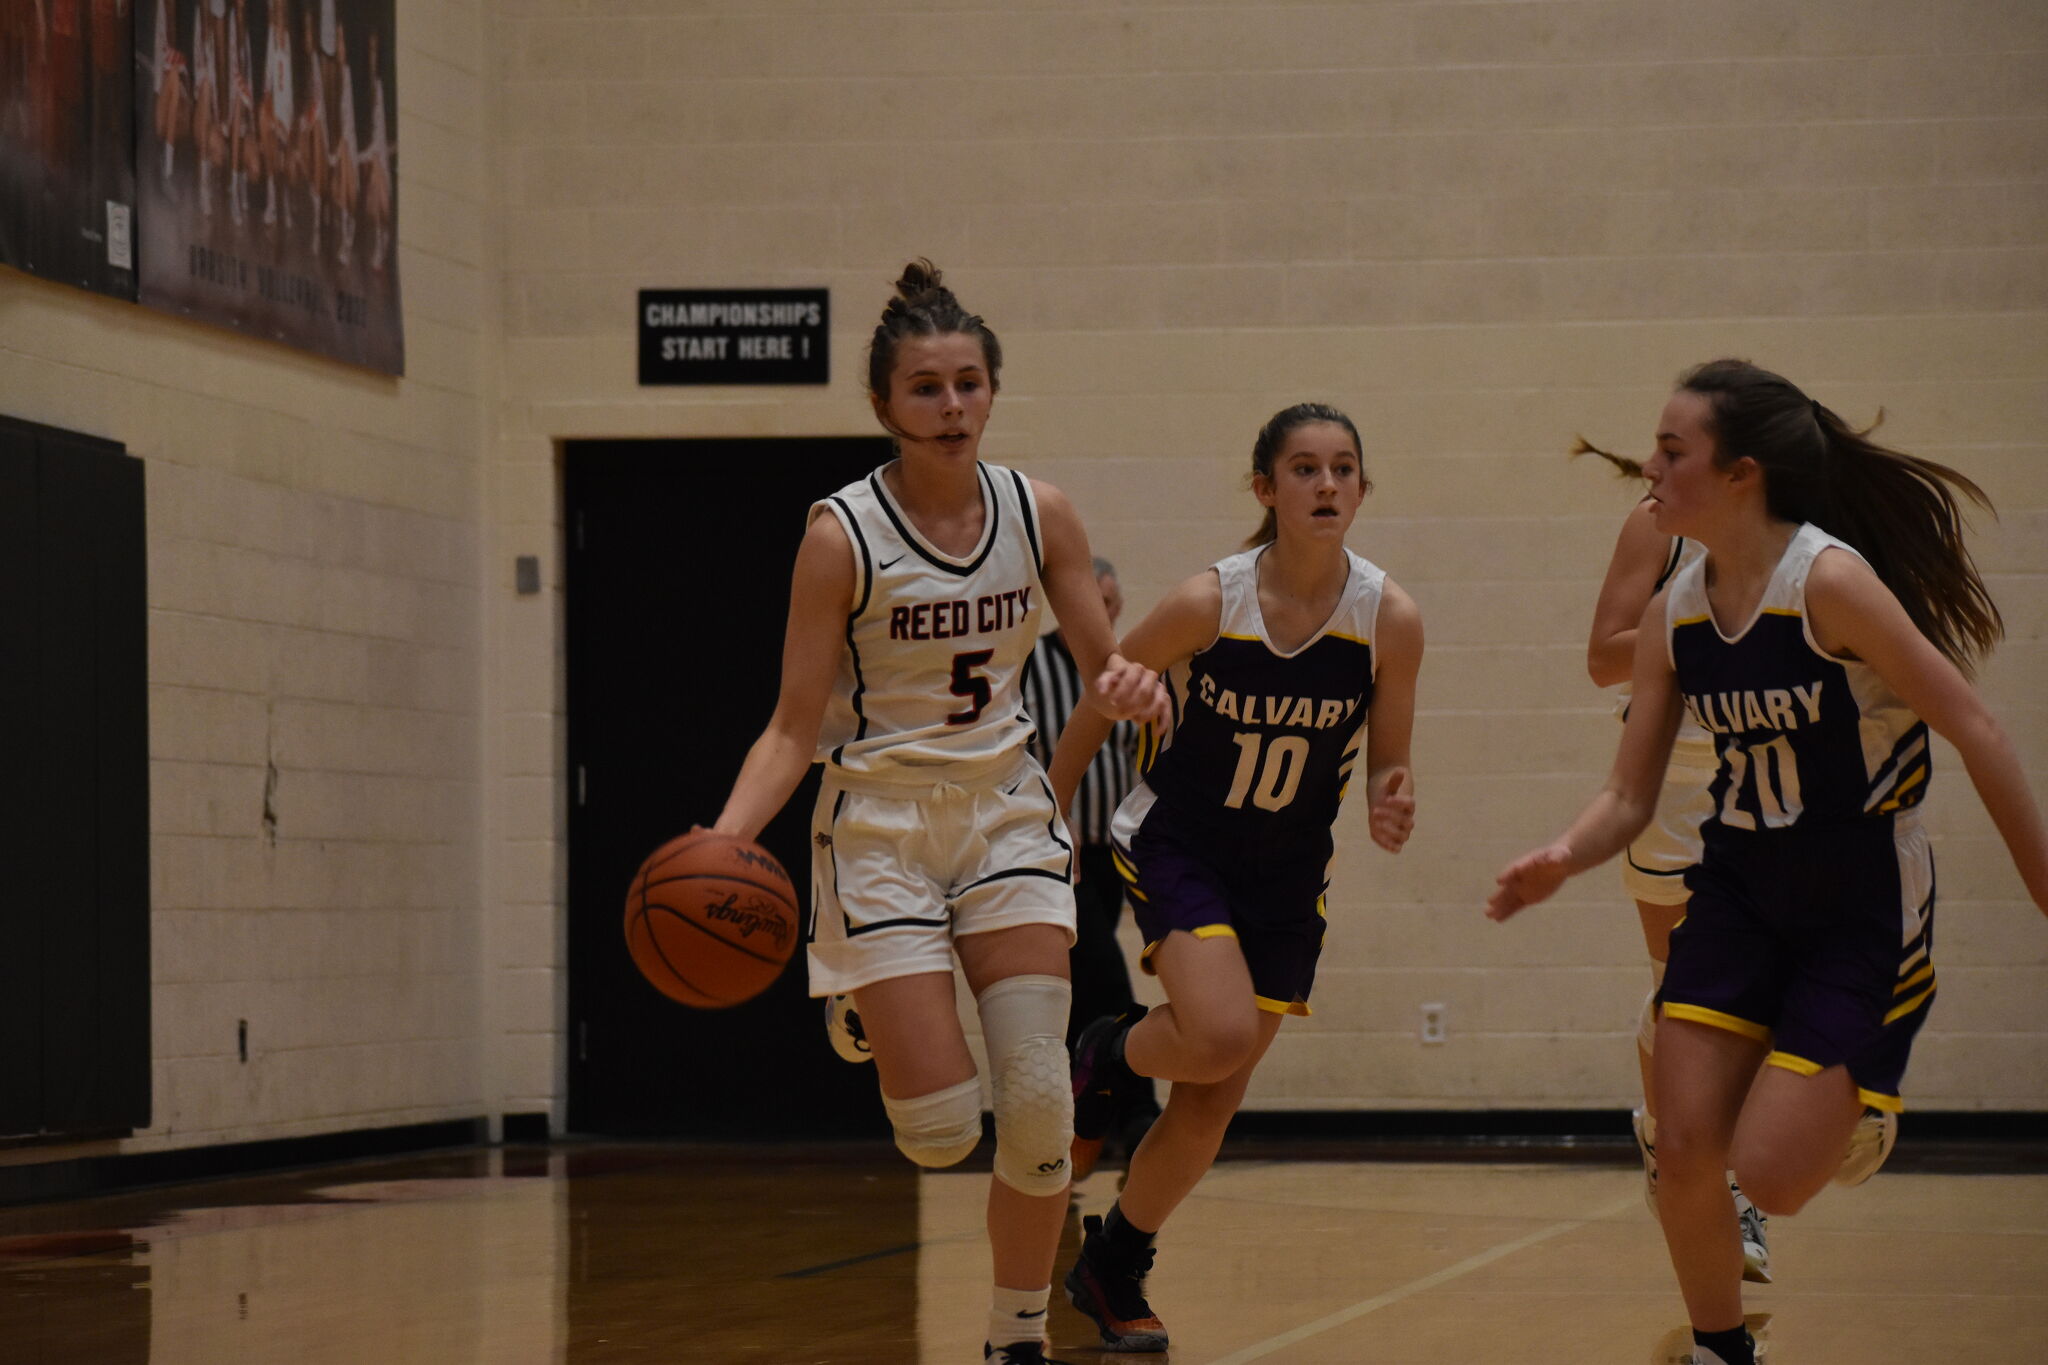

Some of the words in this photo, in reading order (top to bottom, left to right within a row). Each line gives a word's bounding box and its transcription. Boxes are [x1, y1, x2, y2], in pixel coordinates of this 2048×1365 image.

[645, 301, 821, 328] CHAMPIONSHIPS
[661, 336, 730, 361] START
[738, 335, 793, 360] HERE
[890, 600, 969, 640] REED
[978, 586, 1032, 634] CITY
[945, 648, 995, 725] 5
[1200, 672, 1363, 731] CALVARY
[1223, 731, 1310, 813] 10
